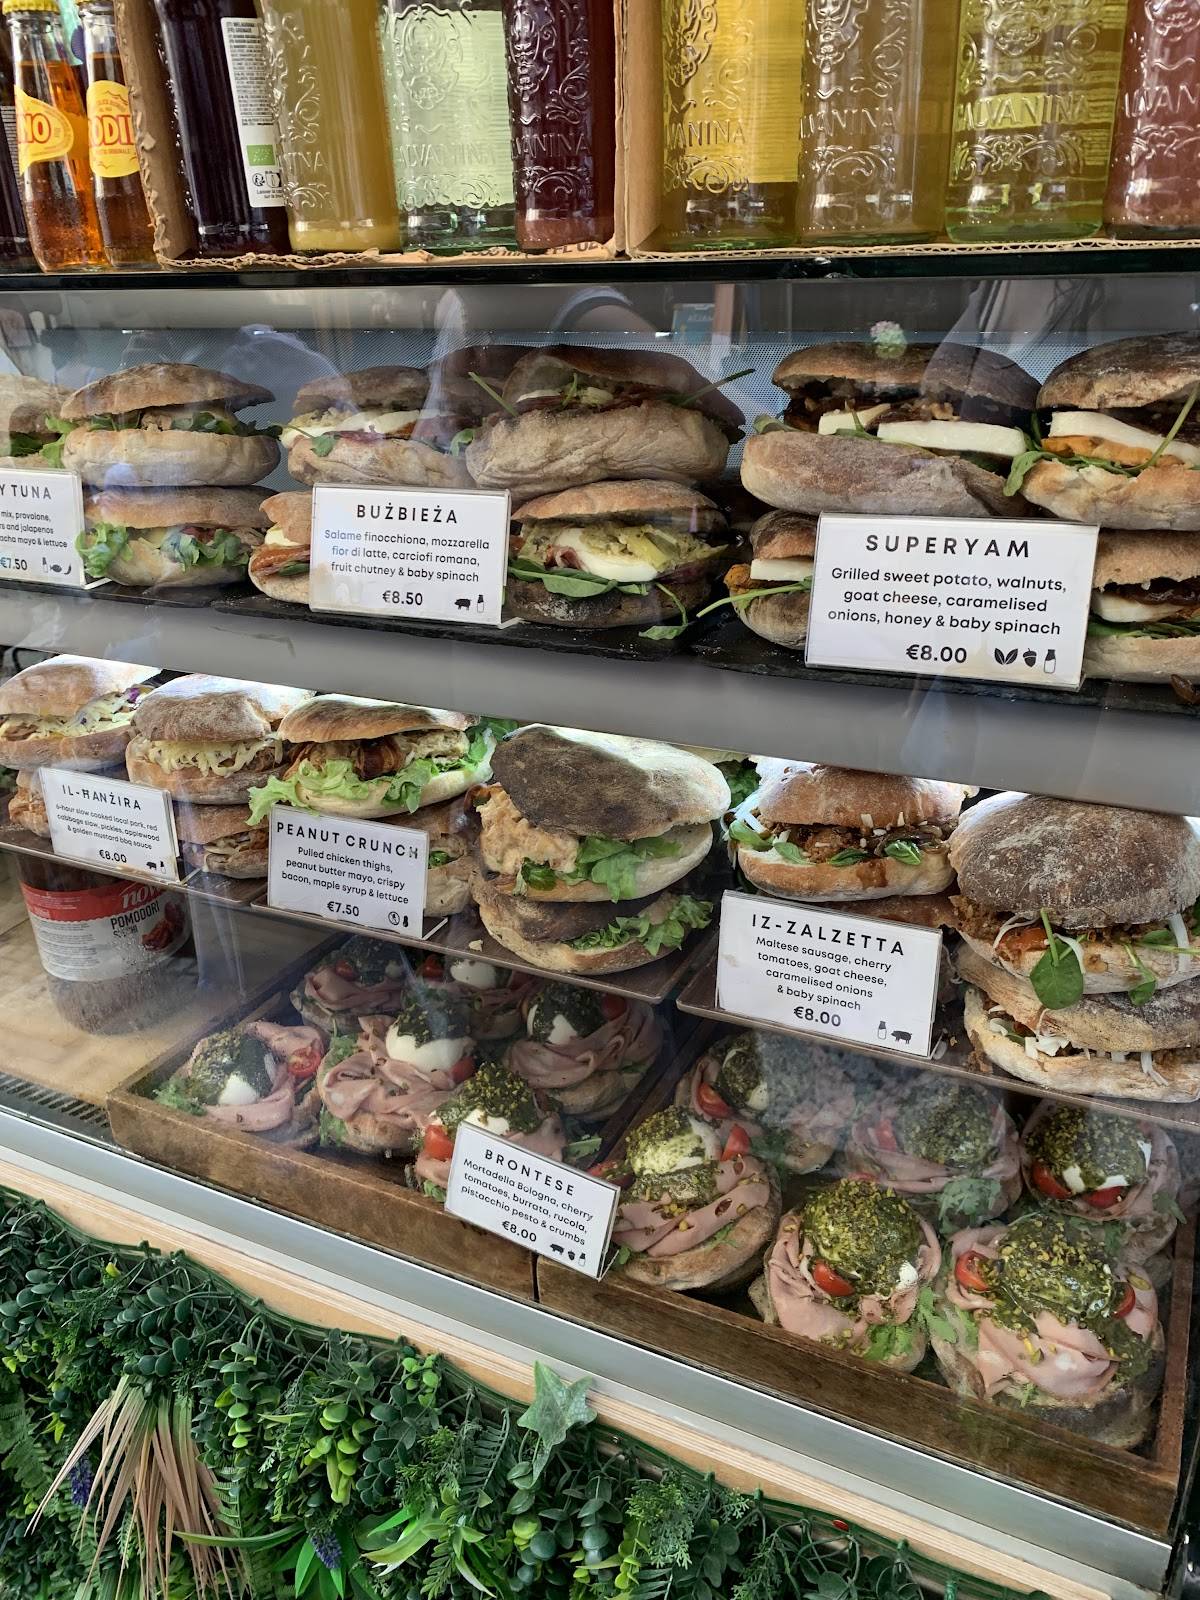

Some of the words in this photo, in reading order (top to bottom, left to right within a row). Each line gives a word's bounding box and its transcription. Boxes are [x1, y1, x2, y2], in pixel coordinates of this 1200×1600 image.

[11, 484, 52, 500] TUNA
[16, 512, 52, 522] provolone,
[356, 502, 458, 524] BUŻBIEŻA
[6, 523, 20, 531] and
[324, 529, 362, 541] Salame
[364, 531, 430, 547] finocchiona,
[431, 537, 490, 550] mozzarella
[18, 536, 36, 546] mayo
[37, 538, 42, 546] &
[43, 540, 68, 548] lettuce
[866, 534, 1030, 558] SUPERYAM
[0, 556, 28, 570] €7.50
[332, 546, 348, 556] fior
[351, 547, 361, 558] di
[363, 548, 390, 561] latte,
[392, 551, 433, 562] carciofi
[435, 555, 480, 567] romana,
[331, 562, 352, 572] fruit
[354, 563, 396, 578] chutney
[398, 566, 405, 577] &
[407, 566, 434, 580] baby
[436, 570, 479, 583] spinach
[832, 567, 880, 582] Grilled
[883, 571, 930, 584] sweet
[934, 573, 992, 590] potato,
[997, 576, 1067, 594] walnuts,
[382, 590, 423, 606] €8.50
[844, 589, 880, 604] goat
[882, 591, 942, 608] cheese,
[946, 596, 1048, 613] caramelised
[828, 609, 880, 625] onions,
[884, 611, 932, 630] honey
[936, 616, 946, 628] &
[950, 616, 990, 633] baby
[994, 619, 1060, 636] spinach
[906, 644, 968, 664] €8.00
[57, 814, 84, 826] cabbage
[101, 822, 124, 834] pickles,
[124, 828, 160, 842] applewood
[76, 808, 90, 816] slow
[90, 811, 113, 822] cooked
[114, 815, 128, 825] local
[130, 820, 147, 830] pork,
[146, 824, 158, 832] red
[67, 824, 73, 832] &
[72, 826, 92, 838] golden
[94, 831, 119, 842] mustard
[120, 836, 133, 847] bbq
[134, 840, 152, 850] sauce
[277, 822, 340, 844] PEANUT
[345, 835, 418, 860] CRUNCH
[99, 850, 128, 864] €8.00
[298, 847, 324, 859] Pulled
[326, 852, 361, 866] chicken
[362, 858, 393, 874] thighs,
[282, 871, 311, 886] bacon,
[313, 878, 341, 891] maple
[342, 884, 367, 898] syrup
[368, 889, 374, 898] &
[376, 890, 410, 904] lettuce
[286, 859, 317, 872] peanut
[318, 864, 346, 878] butter
[348, 871, 376, 885] mayo,
[377, 876, 406, 891] crispy
[110, 902, 161, 930] POMODORI
[327, 901, 360, 917] €7.50
[752, 914, 905, 956] IZ-ZALZETTA
[756, 936, 800, 953] Maltese
[801, 946, 851, 965] sausage,
[854, 956, 892, 974] cherry
[758, 952, 812, 971] tomatoes,
[814, 963, 841, 977] goat
[843, 969, 888, 988] cheese,
[766, 968, 833, 990] caramelised
[836, 983, 874, 999] onions
[776, 984, 784, 994] &
[786, 986, 814, 1002] baby
[816, 993, 862, 1011] spinach
[793, 1006, 842, 1028] €8.00
[484, 1149, 575, 1196] BRONTESE
[464, 1158, 516, 1188] Mortadella
[517, 1181, 560, 1208] Bologna,
[561, 1201, 594, 1223] cherry
[464, 1172, 510, 1201] tomatoes,
[512, 1192, 552, 1218] burrata,
[554, 1212, 588, 1234] rucola,
[461, 1185, 510, 1212] pistacchio
[512, 1207, 540, 1226] pesto
[540, 1220, 548, 1229] &
[549, 1223, 586, 1246] crumbs
[502, 1220, 538, 1243] €8.00
